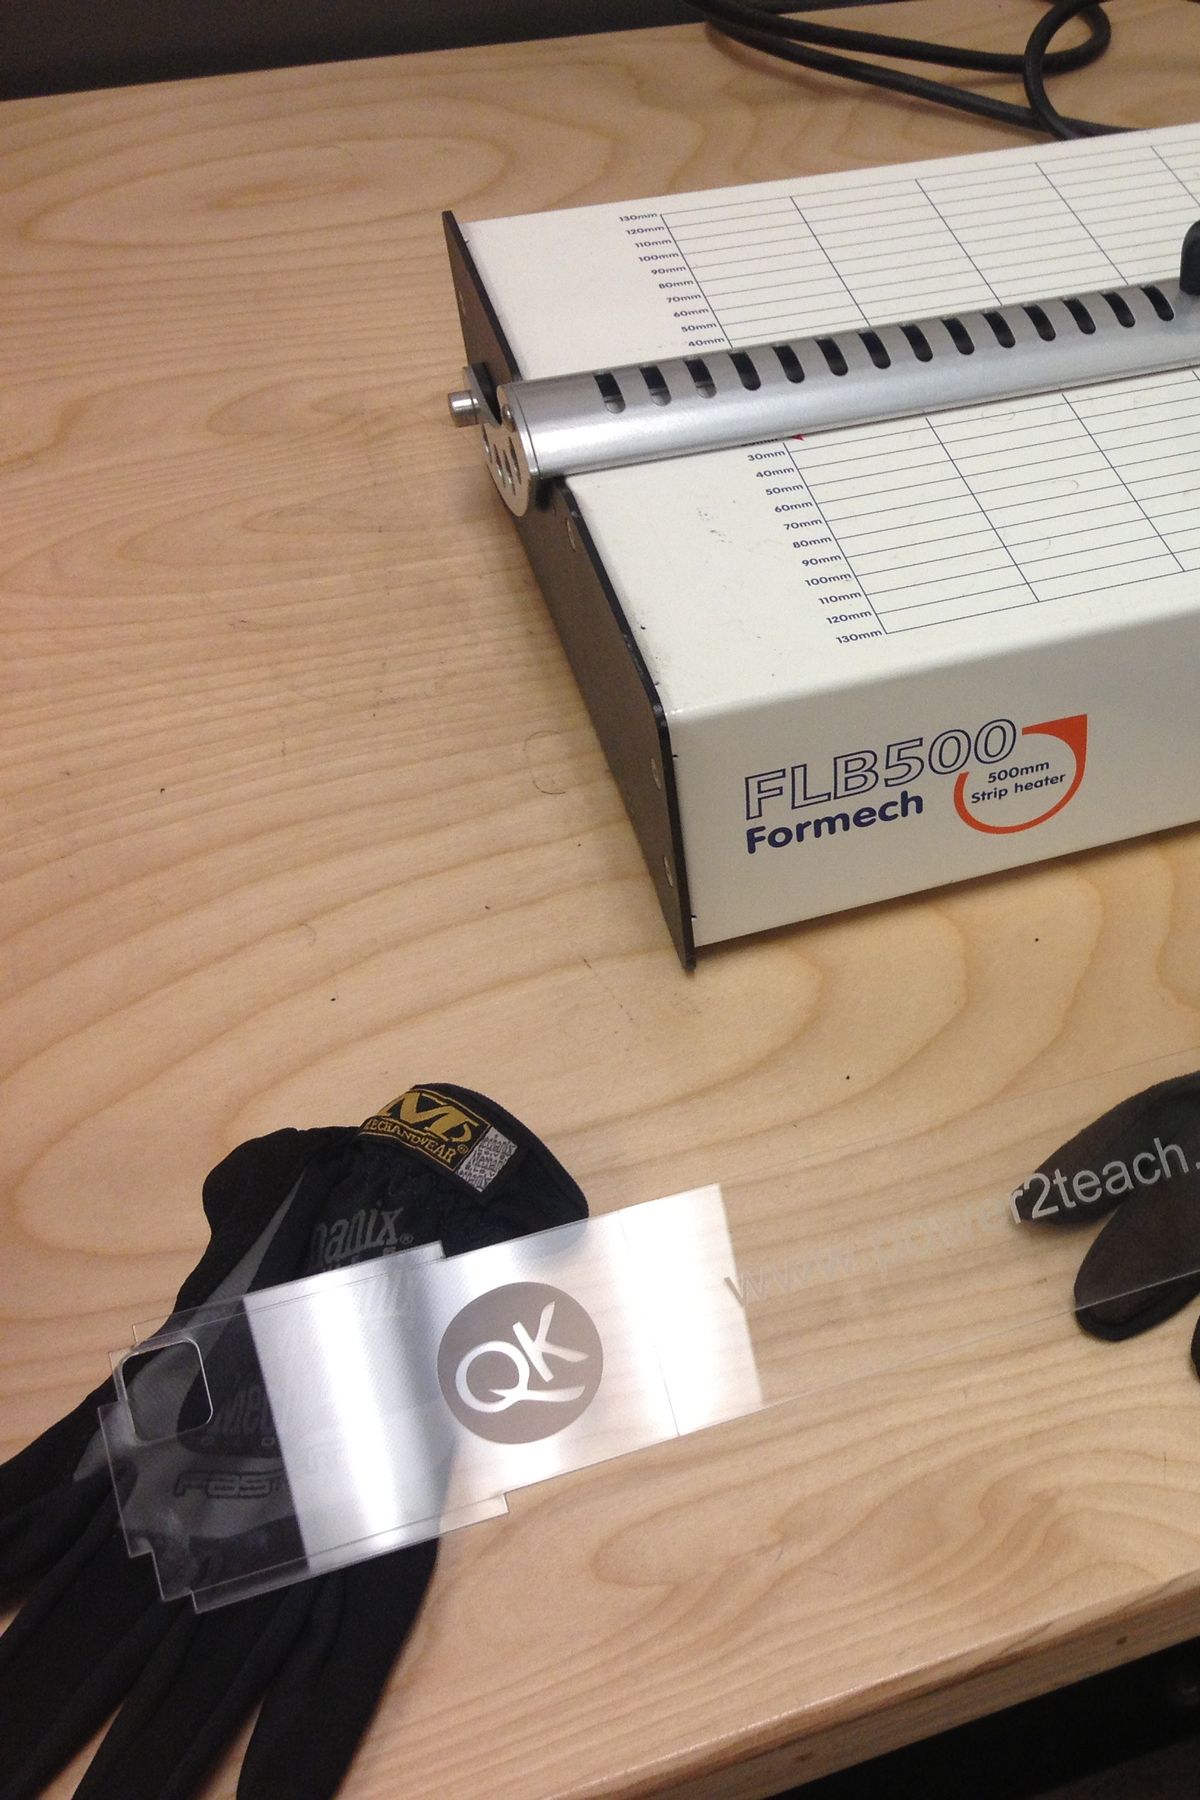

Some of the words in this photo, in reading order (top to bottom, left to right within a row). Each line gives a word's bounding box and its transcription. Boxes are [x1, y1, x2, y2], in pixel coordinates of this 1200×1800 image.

[618, 212, 658, 222] 130mm
[626, 225, 665, 235] 120mm
[634, 239, 672, 248] 110mm
[638, 252, 680, 262] 100mm
[650, 265, 687, 275] 90mm
[658, 279, 694, 289] 80mm
[666, 293, 702, 303] 70mm
[673, 308, 709, 318] 60mm
[681, 322, 717, 333] 50mm
[688, 337, 725, 347] 40mm
[747, 450, 786, 462] 30mm
[755, 467, 795, 479] 40mm
[765, 484, 804, 496] 50mm
[774, 501, 814, 513] 60mm
[783, 518, 823, 531] 70mm
[792, 536, 832, 549] 80mm
[801, 554, 842, 567] 90mm
[805, 572, 853, 587] 100mm
[818, 591, 863, 605] 110mm
[826, 610, 873, 625] 120mm
[836, 629, 883, 644] 130mm
[744, 718, 1018, 821] FLB500
[987, 761, 1050, 784] 500mm
[971, 785, 1009, 804] Strip
[1014, 772, 1067, 795] heater
[746, 790, 924, 854] Formech
[455, 1300, 589, 1414] QK
